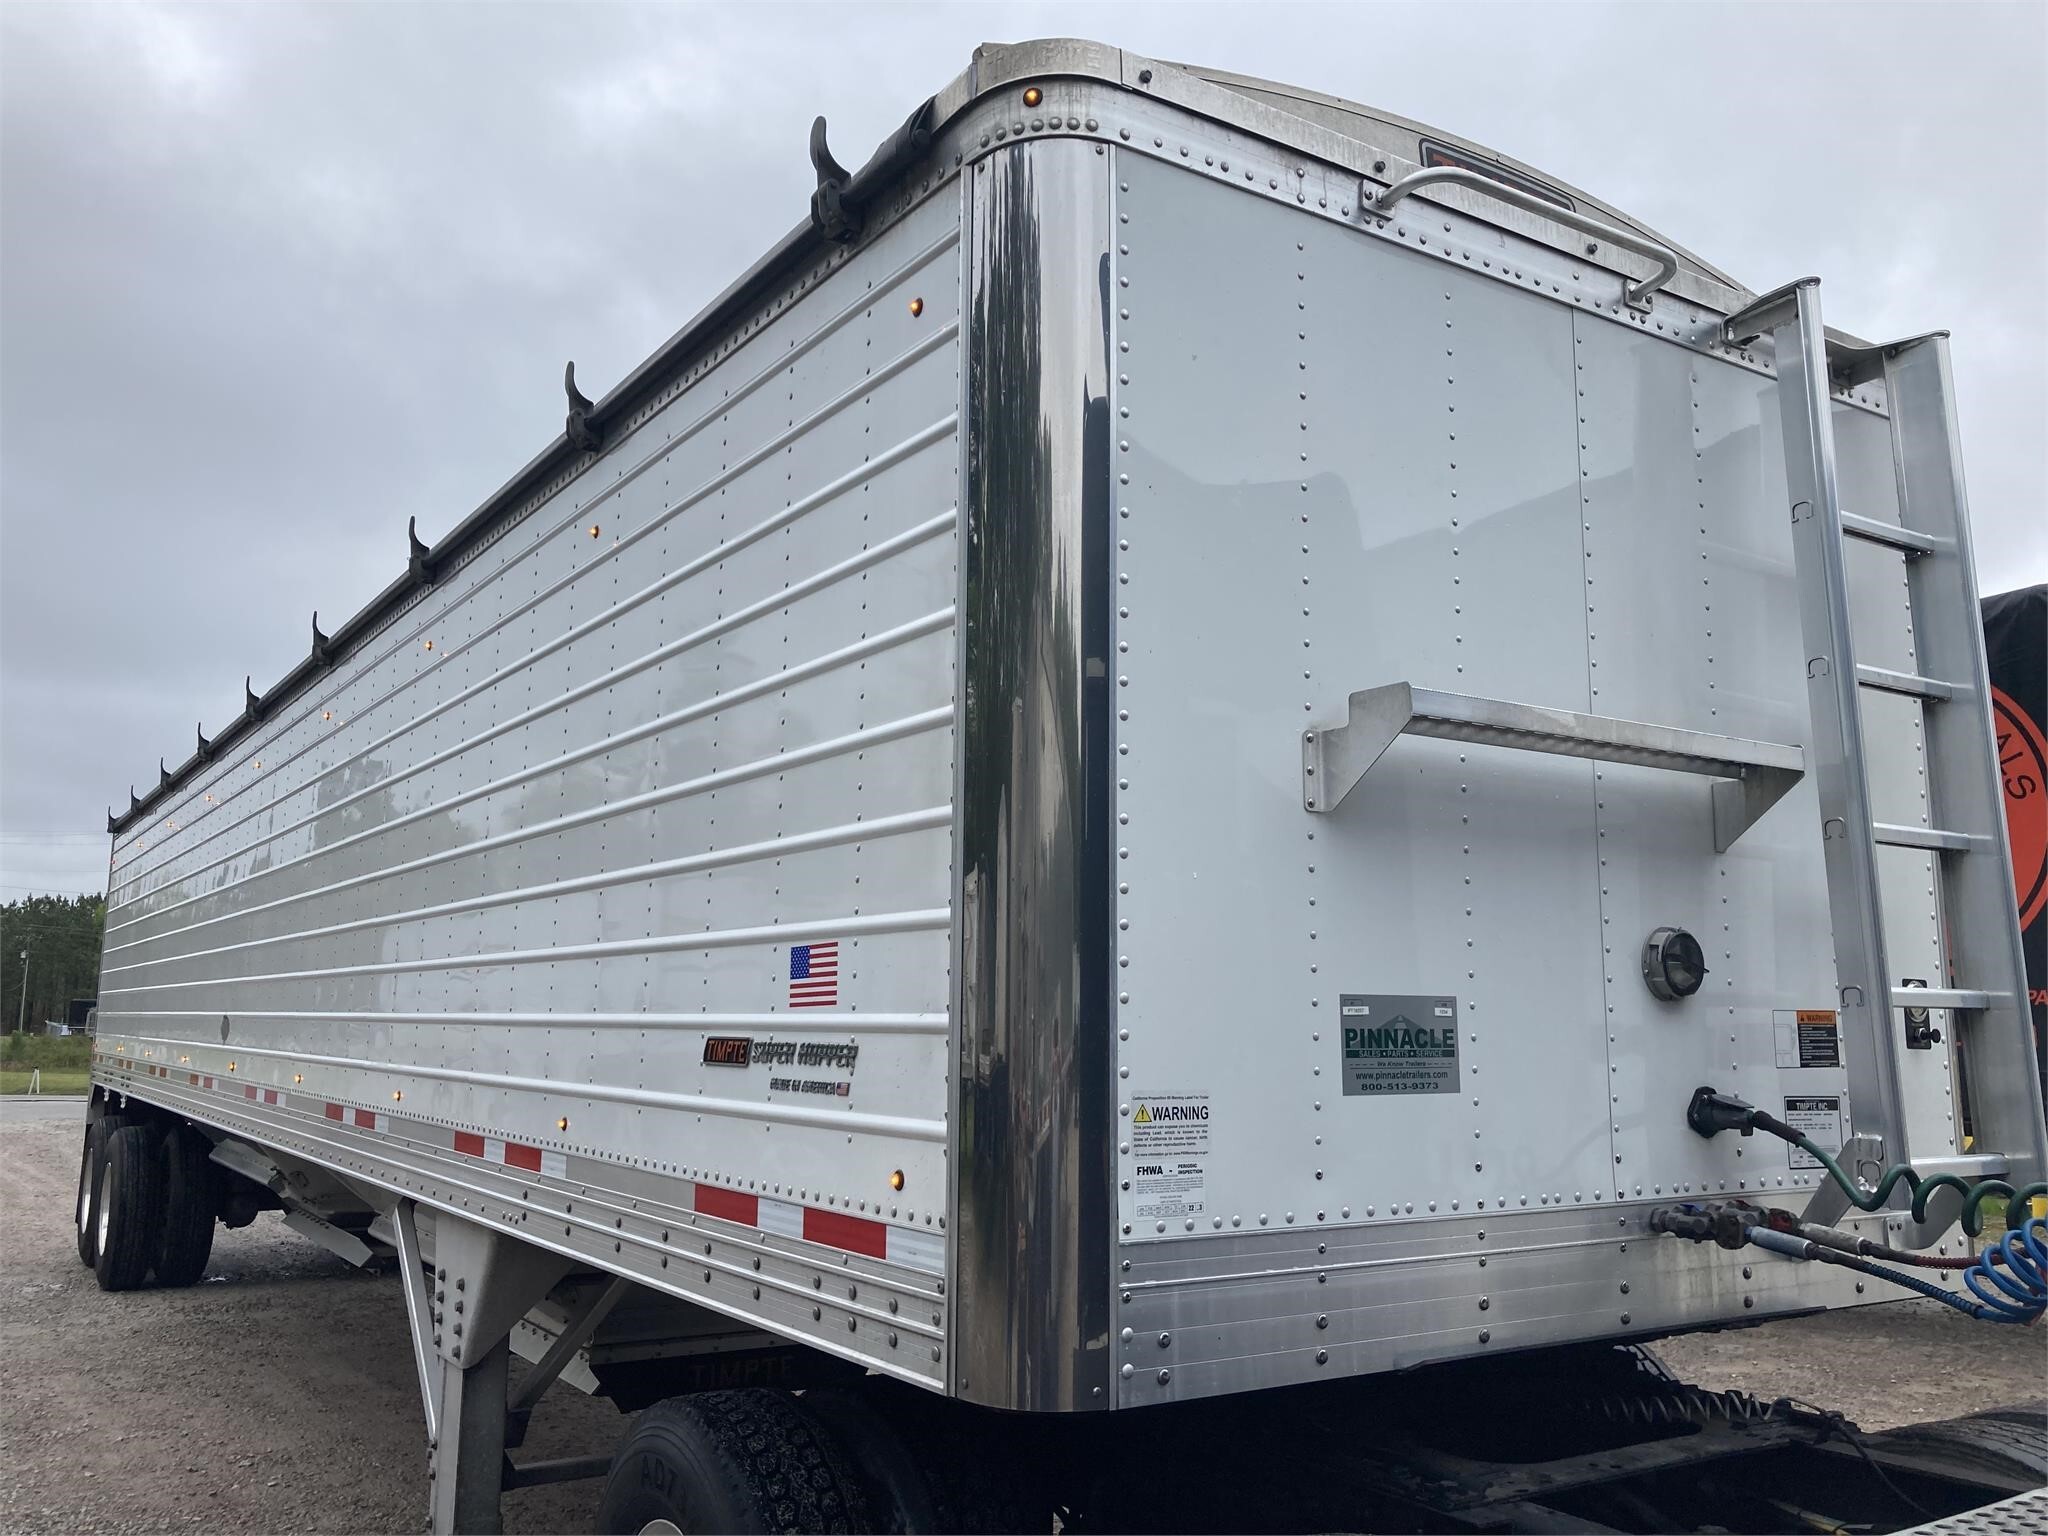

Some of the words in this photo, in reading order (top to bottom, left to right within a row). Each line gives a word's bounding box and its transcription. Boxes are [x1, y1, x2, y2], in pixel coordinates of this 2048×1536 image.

[1345, 1028, 1454, 1048] PINNACLE
[708, 1040, 748, 1063] TIMPTE
[1359, 1050, 1380, 1058] SALES
[1387, 1050, 1409, 1058] PARTS
[1356, 1071, 1448, 1081] www.pinnacletrailers.com
[1361, 1082, 1439, 1091] 800-513-9373
[1152, 1106, 1208, 1121] WARNING
[1137, 1165, 1163, 1176] FHWA
